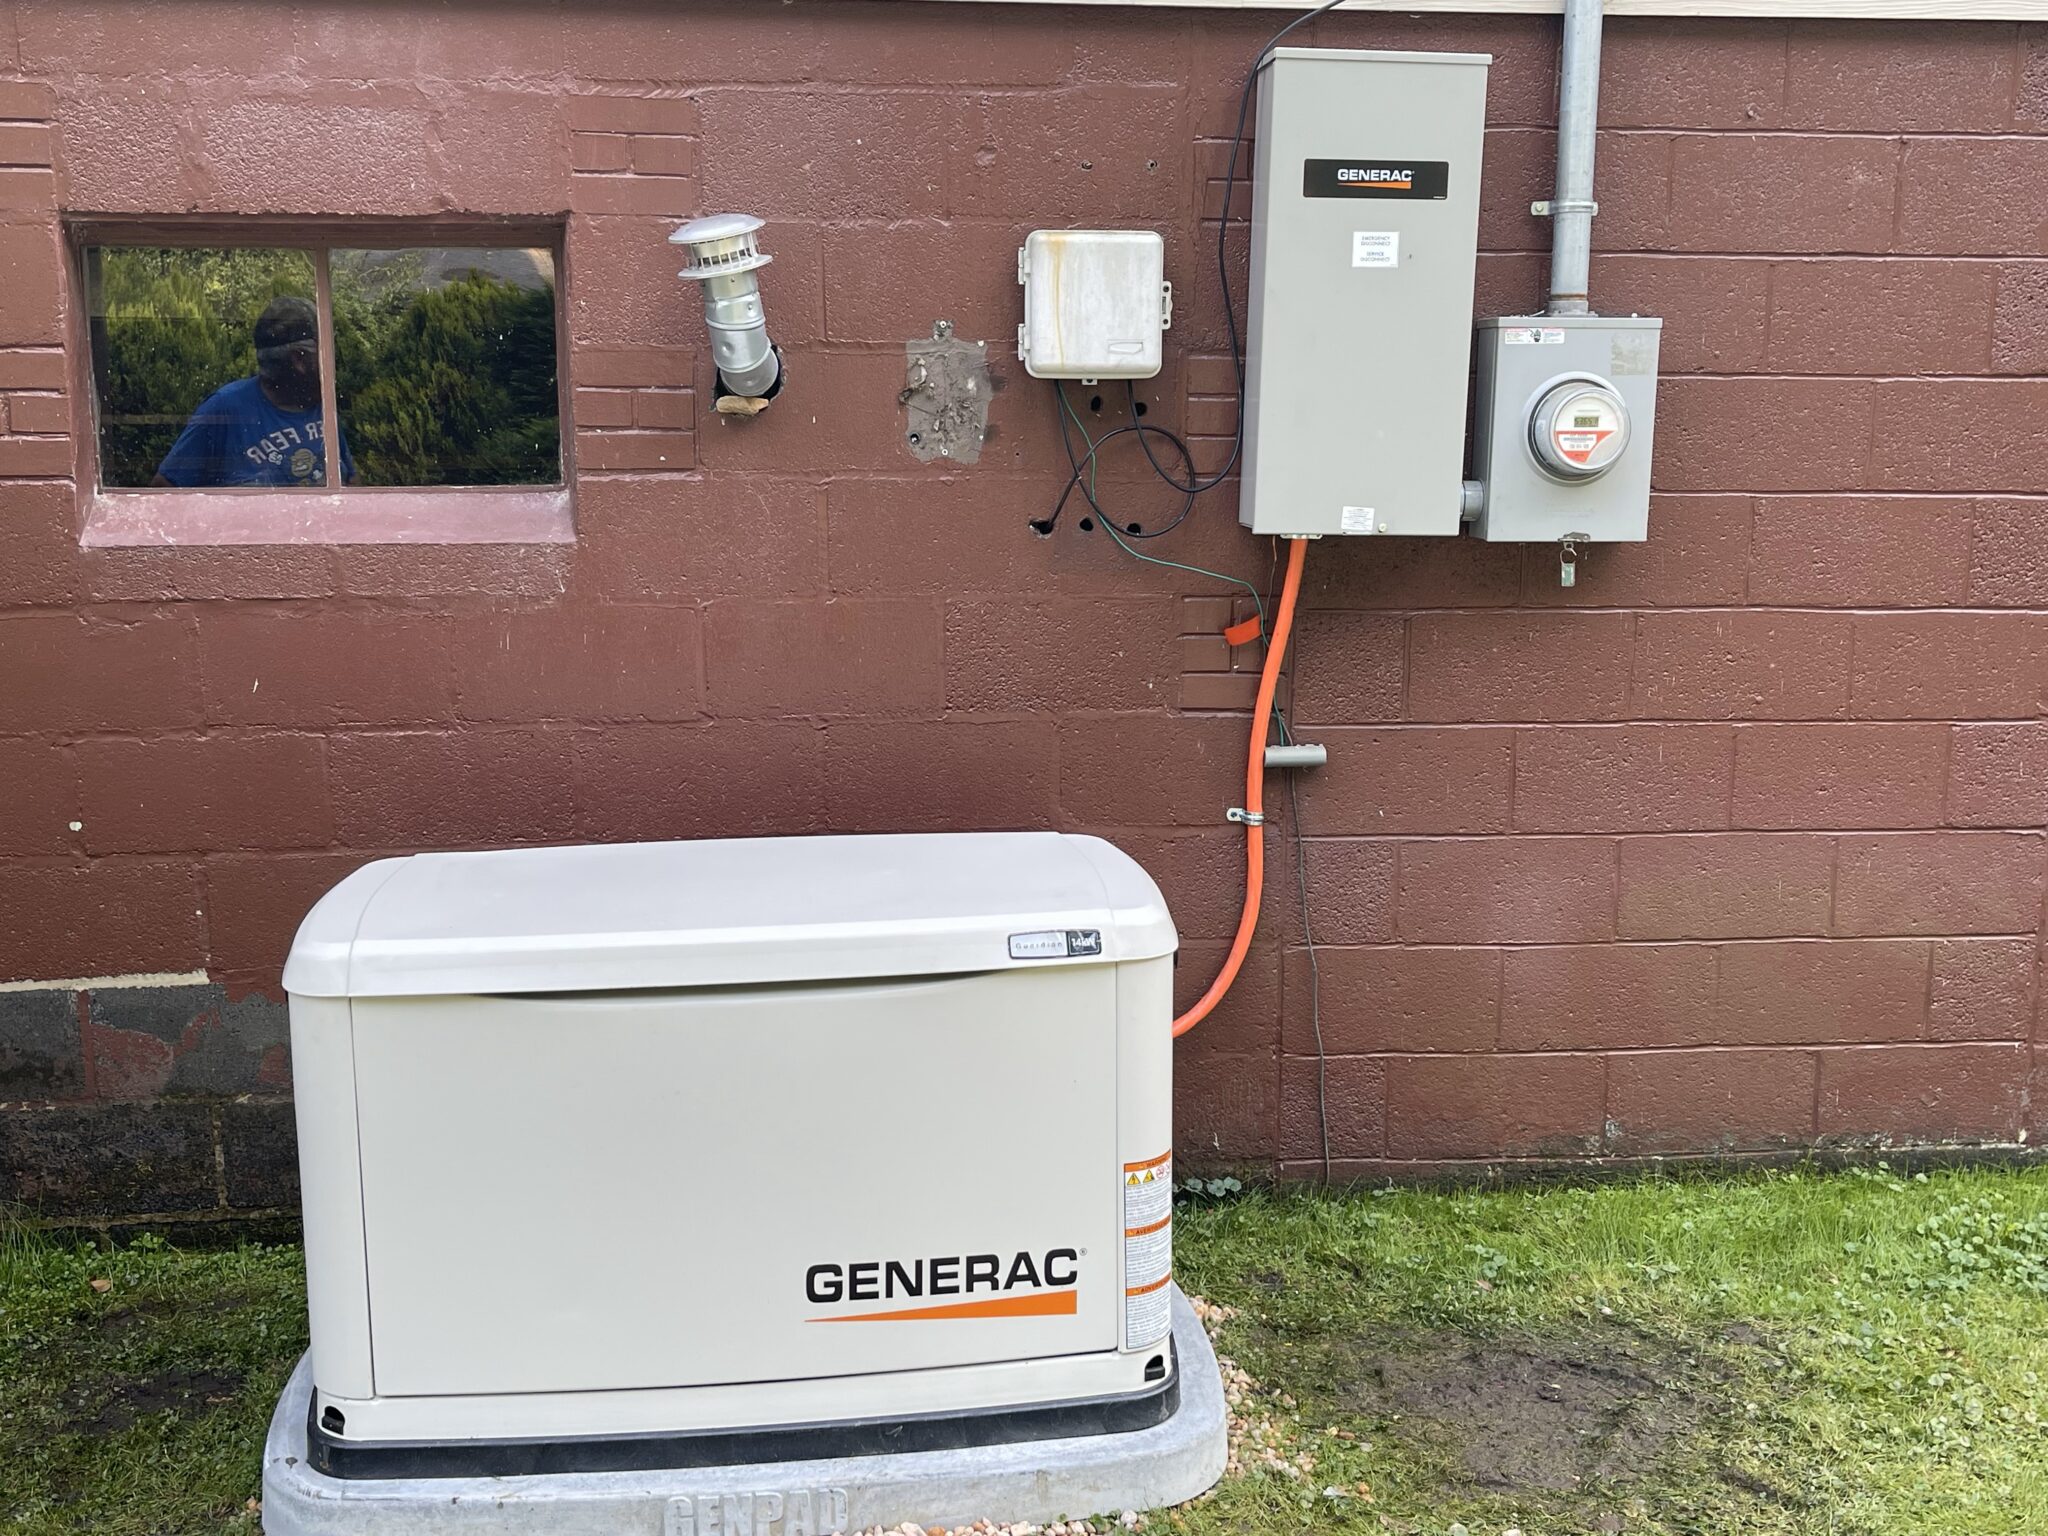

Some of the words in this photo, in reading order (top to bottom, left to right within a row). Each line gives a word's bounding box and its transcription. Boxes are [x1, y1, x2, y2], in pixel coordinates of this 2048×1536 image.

[1337, 168, 1412, 181] GENERAC
[806, 1248, 1078, 1303] GENERAC
[664, 1487, 849, 1536] GENPAD
